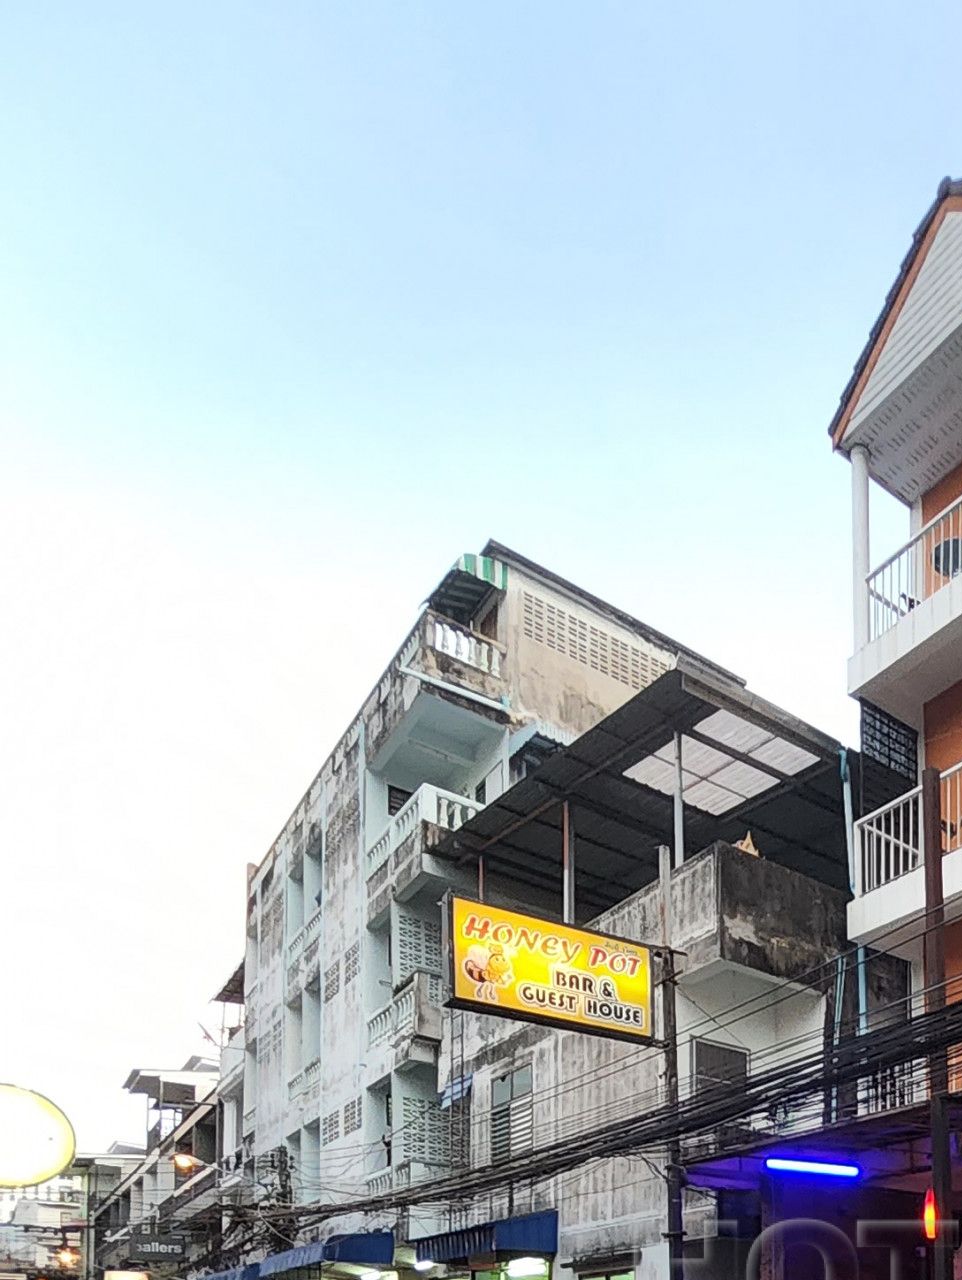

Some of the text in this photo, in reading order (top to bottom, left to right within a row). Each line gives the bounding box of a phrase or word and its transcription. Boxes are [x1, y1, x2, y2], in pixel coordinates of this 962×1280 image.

[465, 915, 582, 963] HONEY
[590, 947, 642, 976] POT
[555, 971, 613, 999] BAR &
[522, 986, 642, 1024] GUEST HOUSE
